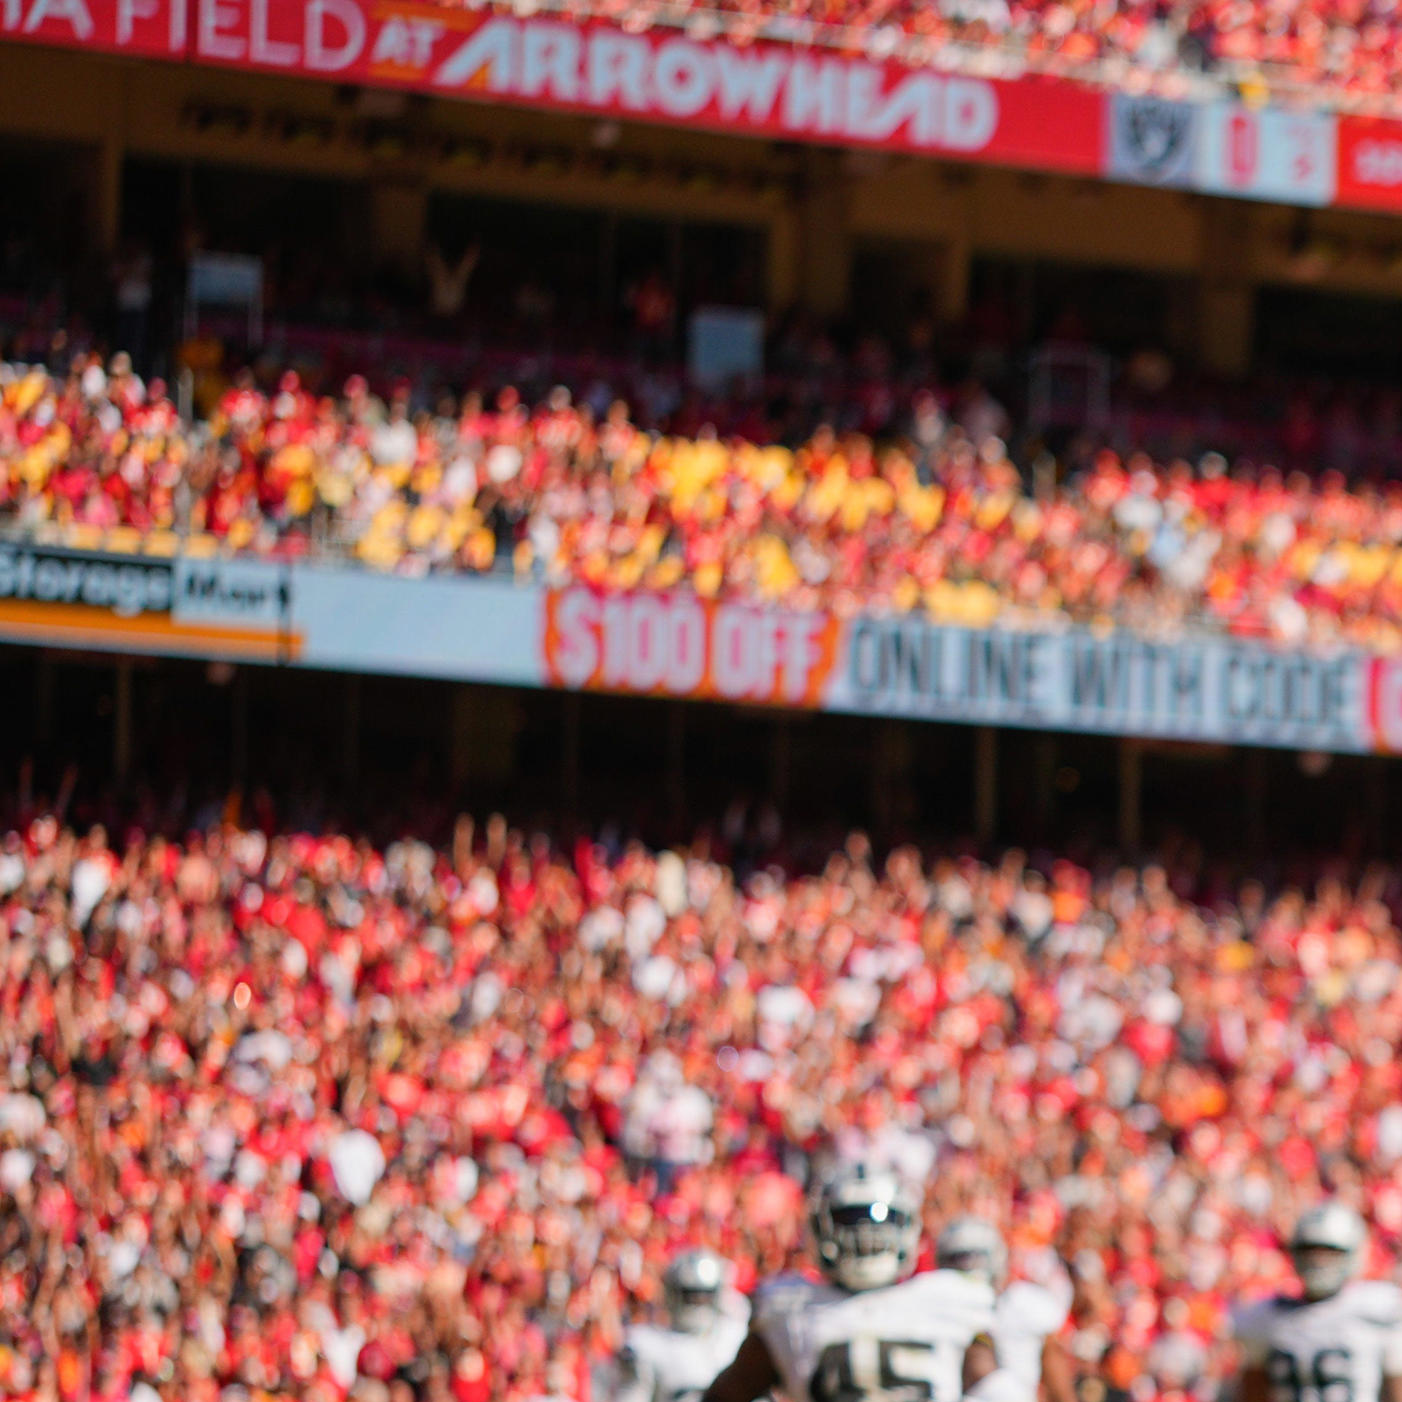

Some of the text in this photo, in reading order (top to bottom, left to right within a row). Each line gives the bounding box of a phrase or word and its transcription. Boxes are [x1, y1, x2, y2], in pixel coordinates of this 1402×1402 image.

[115, 0, 366, 71] FIELD
[372, 17, 443, 67] AT
[432, 18, 998, 152] ARROWHEAD
[554, 590, 825, 703] $100 OFF
[850, 617, 1362, 732] ONLINE WITH CODE
